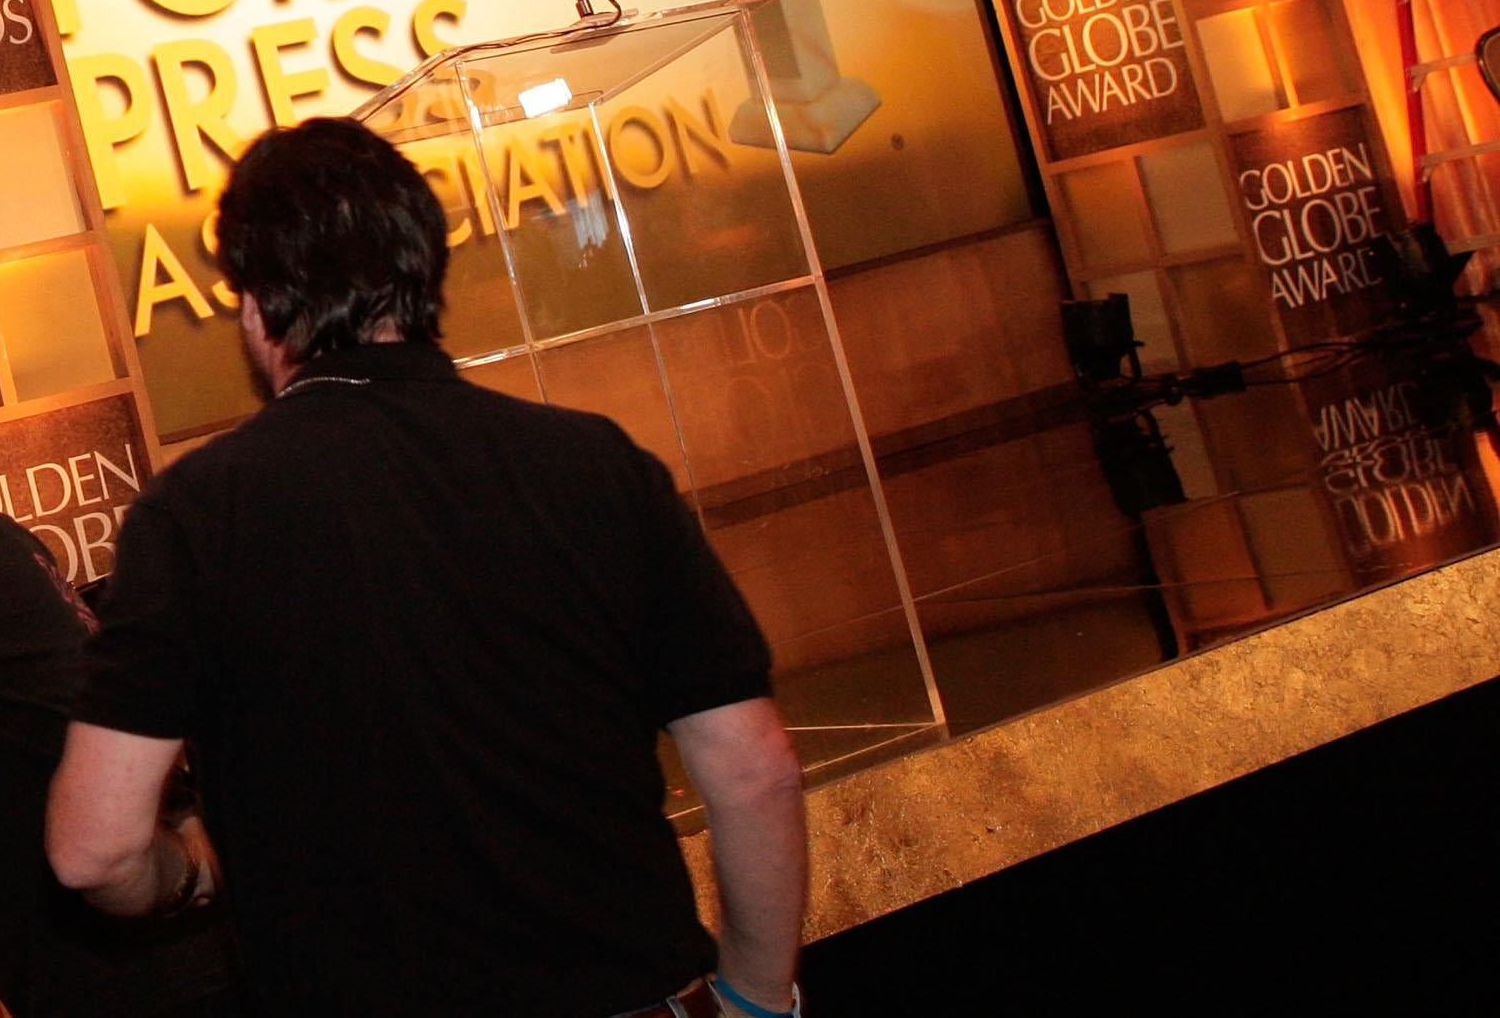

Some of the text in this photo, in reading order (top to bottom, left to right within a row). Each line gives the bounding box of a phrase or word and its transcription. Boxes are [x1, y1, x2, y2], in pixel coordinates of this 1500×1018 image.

[1047, 57, 1178, 125] AWARD
[1240, 142, 1373, 211] GOLDEN
[1253, 186, 1382, 266] GLOBE
